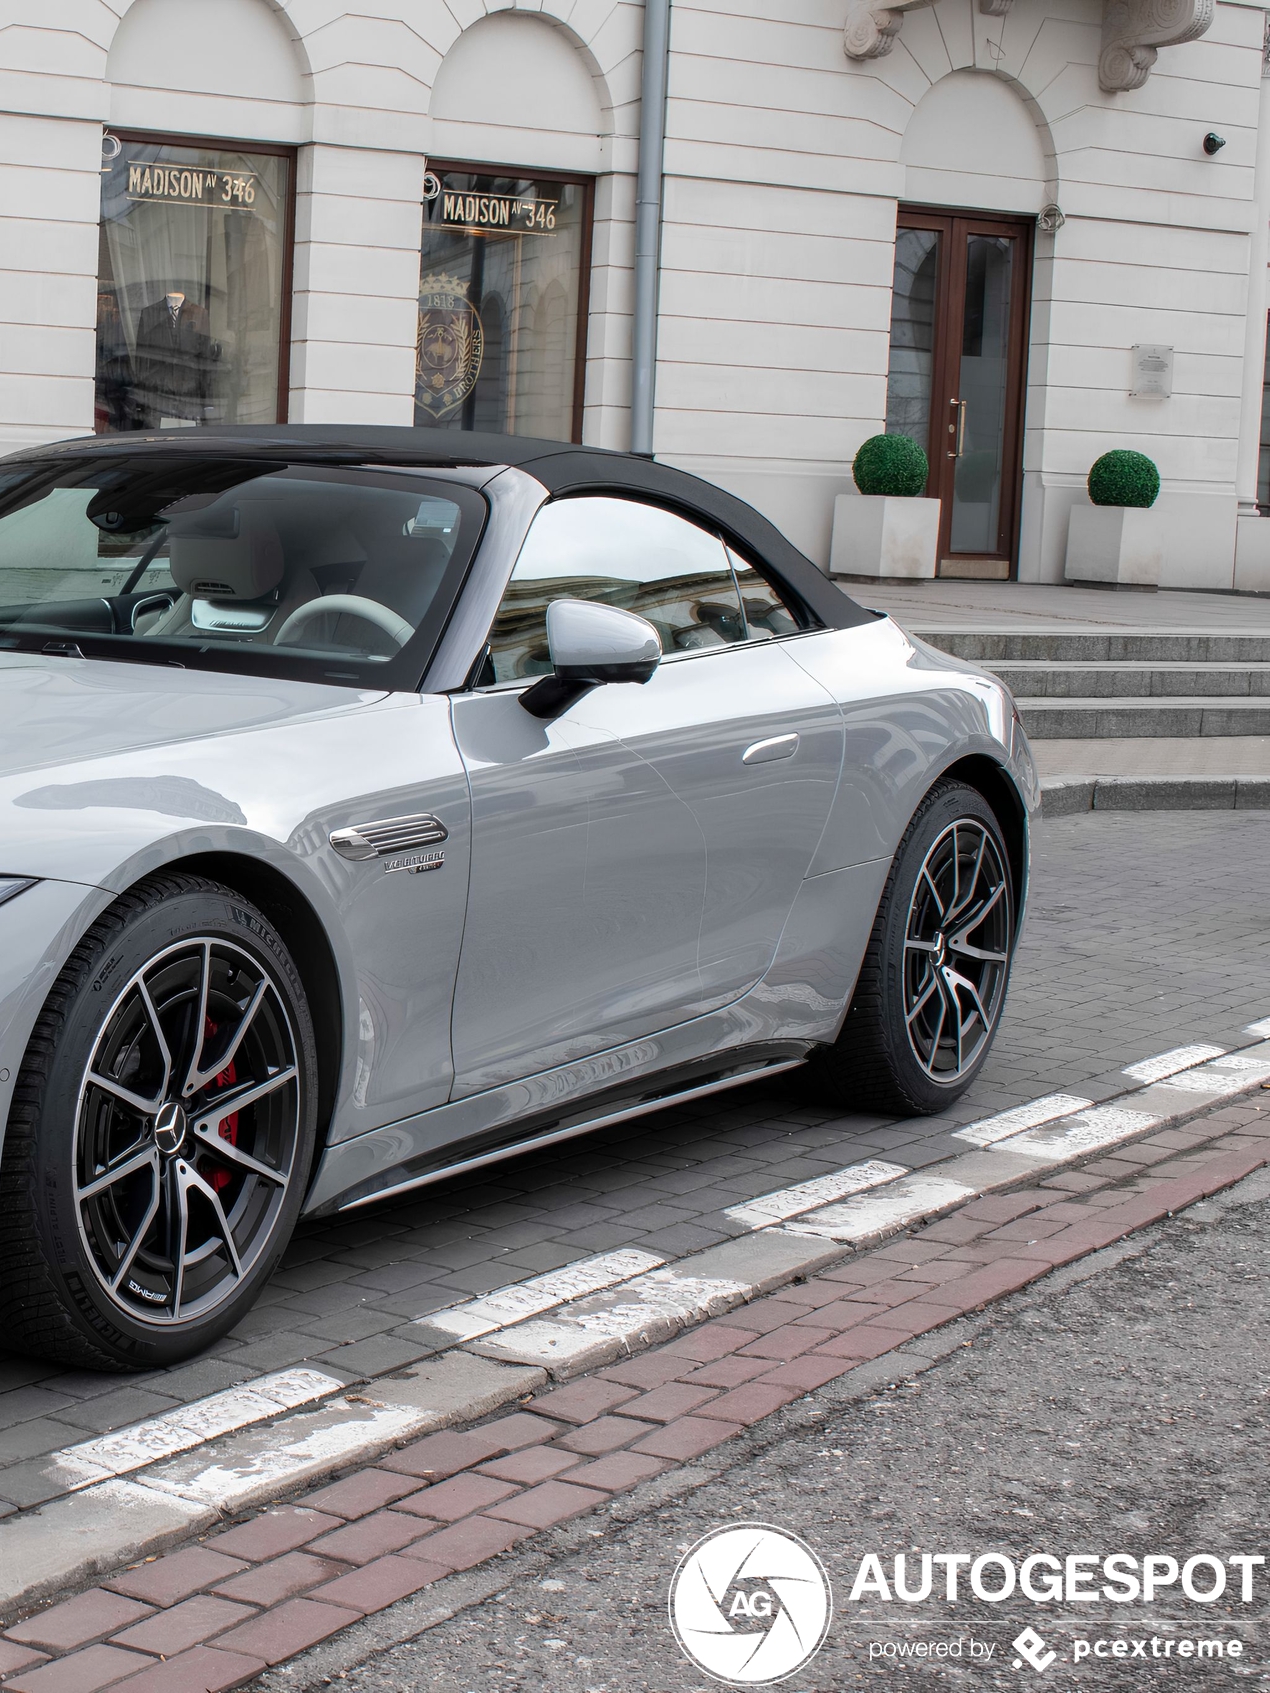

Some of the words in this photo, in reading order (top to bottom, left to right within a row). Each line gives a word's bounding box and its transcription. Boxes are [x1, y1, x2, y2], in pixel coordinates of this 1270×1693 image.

[128, 166, 203, 198] MADISON
[205, 174, 217, 188] AV
[221, 175, 255, 203] 346
[443, 194, 509, 225] MADISON
[511, 201, 522, 214] AV
[525, 203, 556, 229] 346
[427, 294, 455, 308] 1818
[453, 329, 482, 399] BROTHERS
[129, 1279, 157, 1301] AMG
